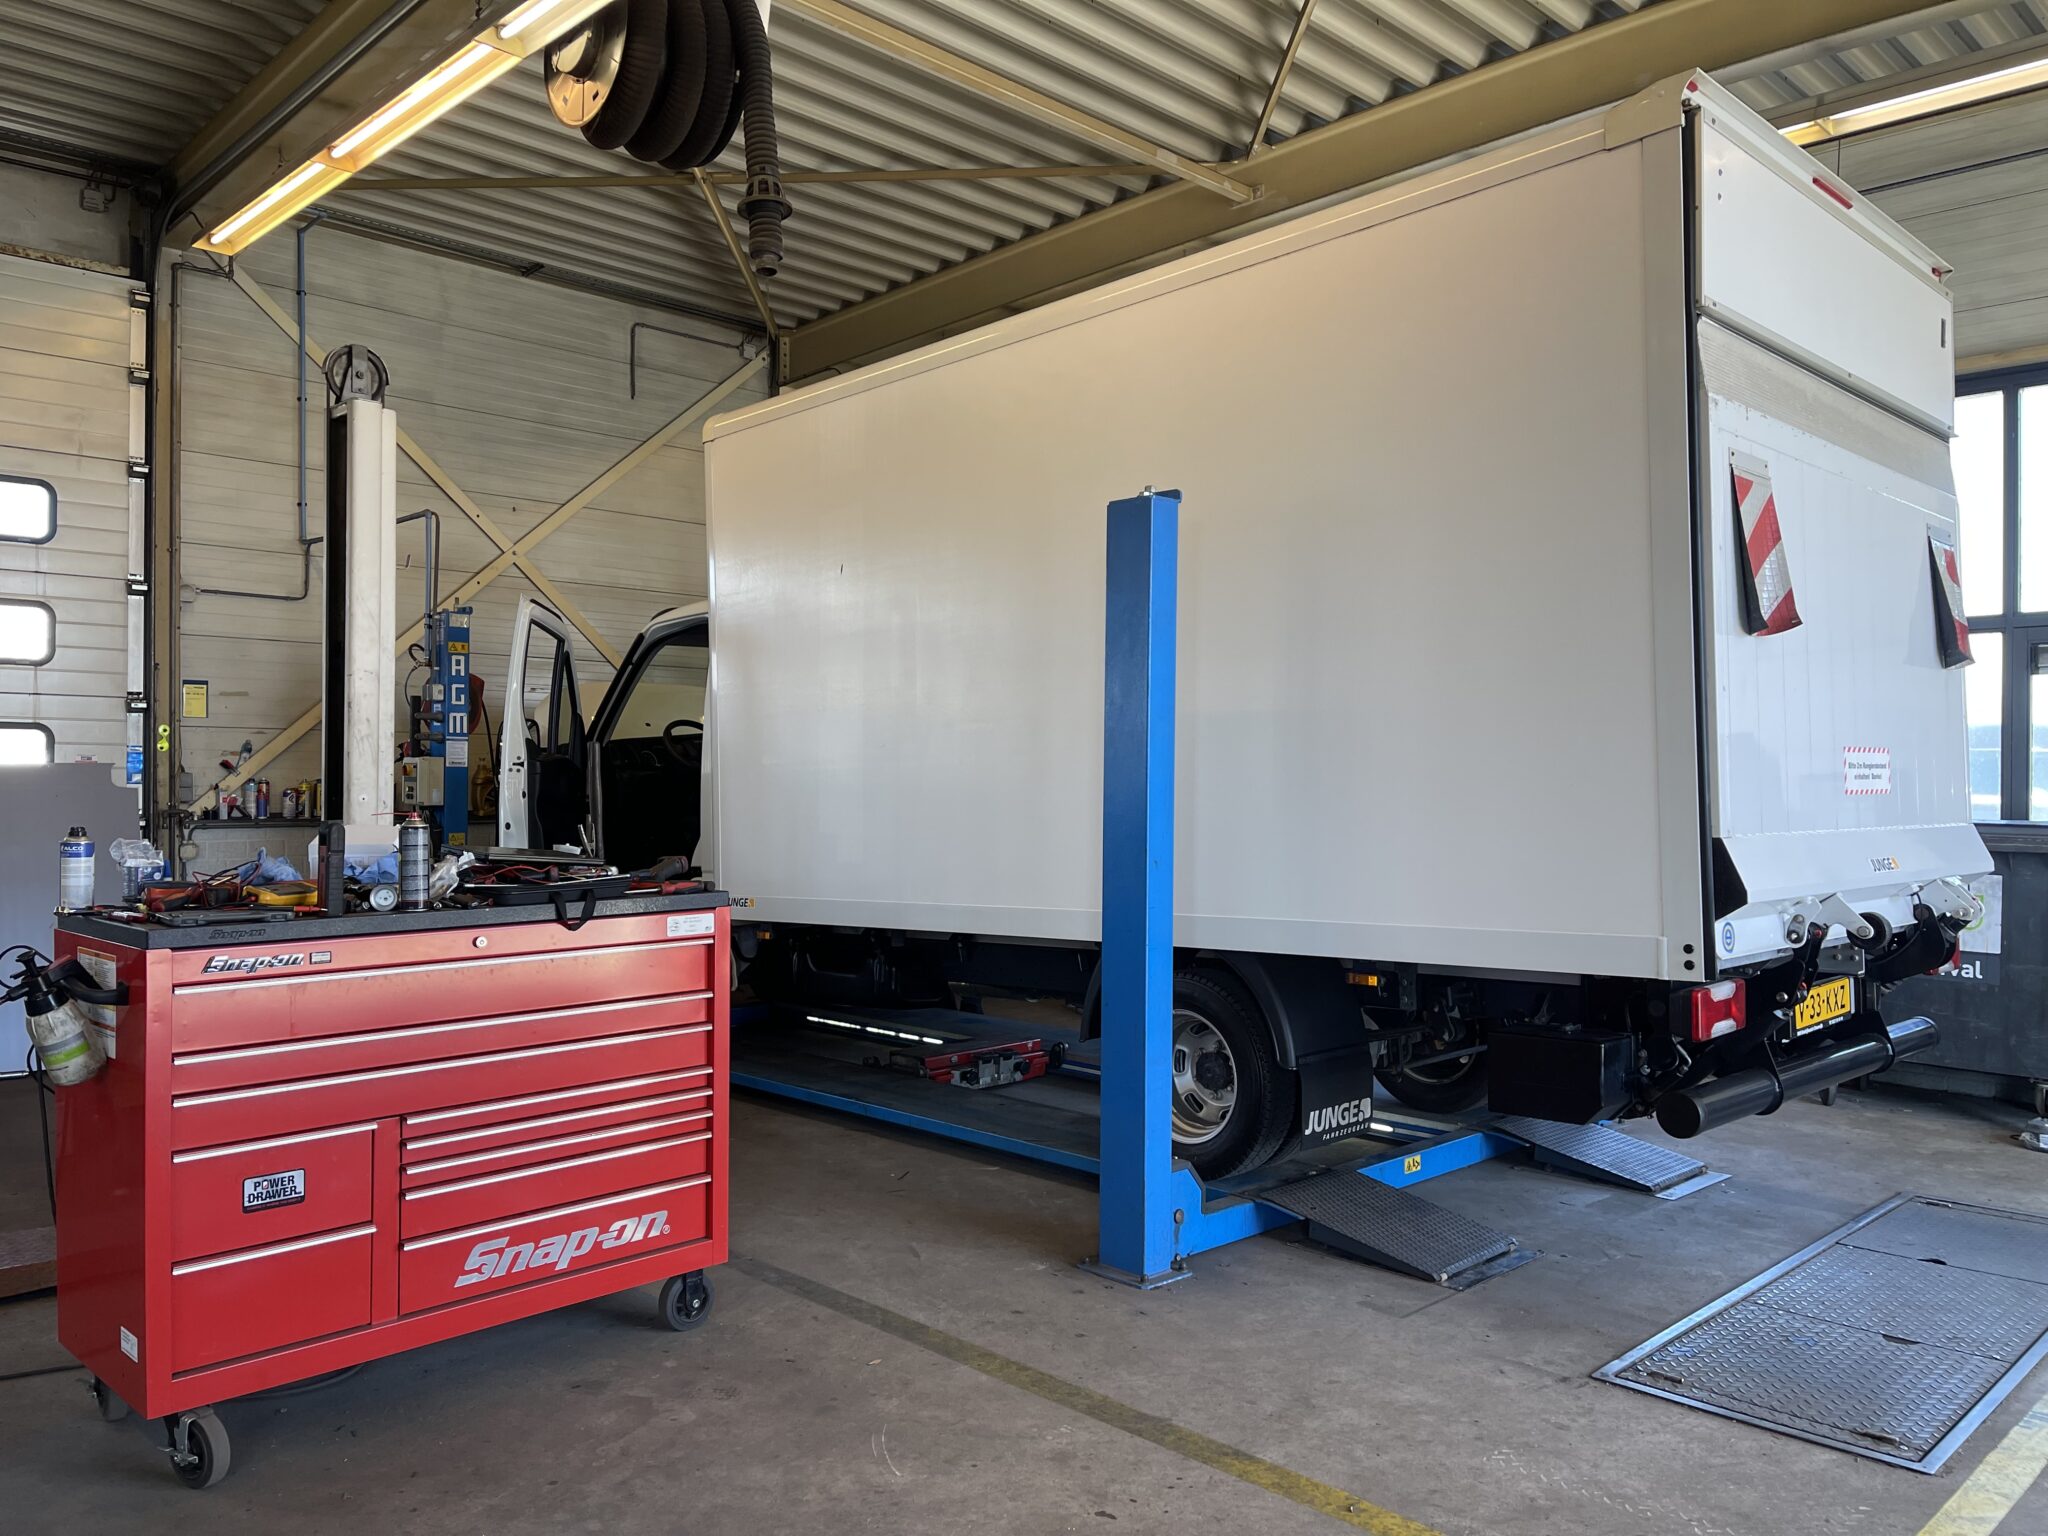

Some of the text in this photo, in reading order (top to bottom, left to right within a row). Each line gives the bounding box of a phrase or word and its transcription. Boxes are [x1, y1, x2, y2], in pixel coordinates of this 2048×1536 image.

[1870, 857, 1895, 872] JUNGE
[728, 897, 749, 908] UNGE
[201, 953, 304, 974] Snap-on
[253, 1175, 295, 1192] POWER
[247, 1185, 298, 1204] DRAWER
[454, 1210, 668, 1288] Snap-on
